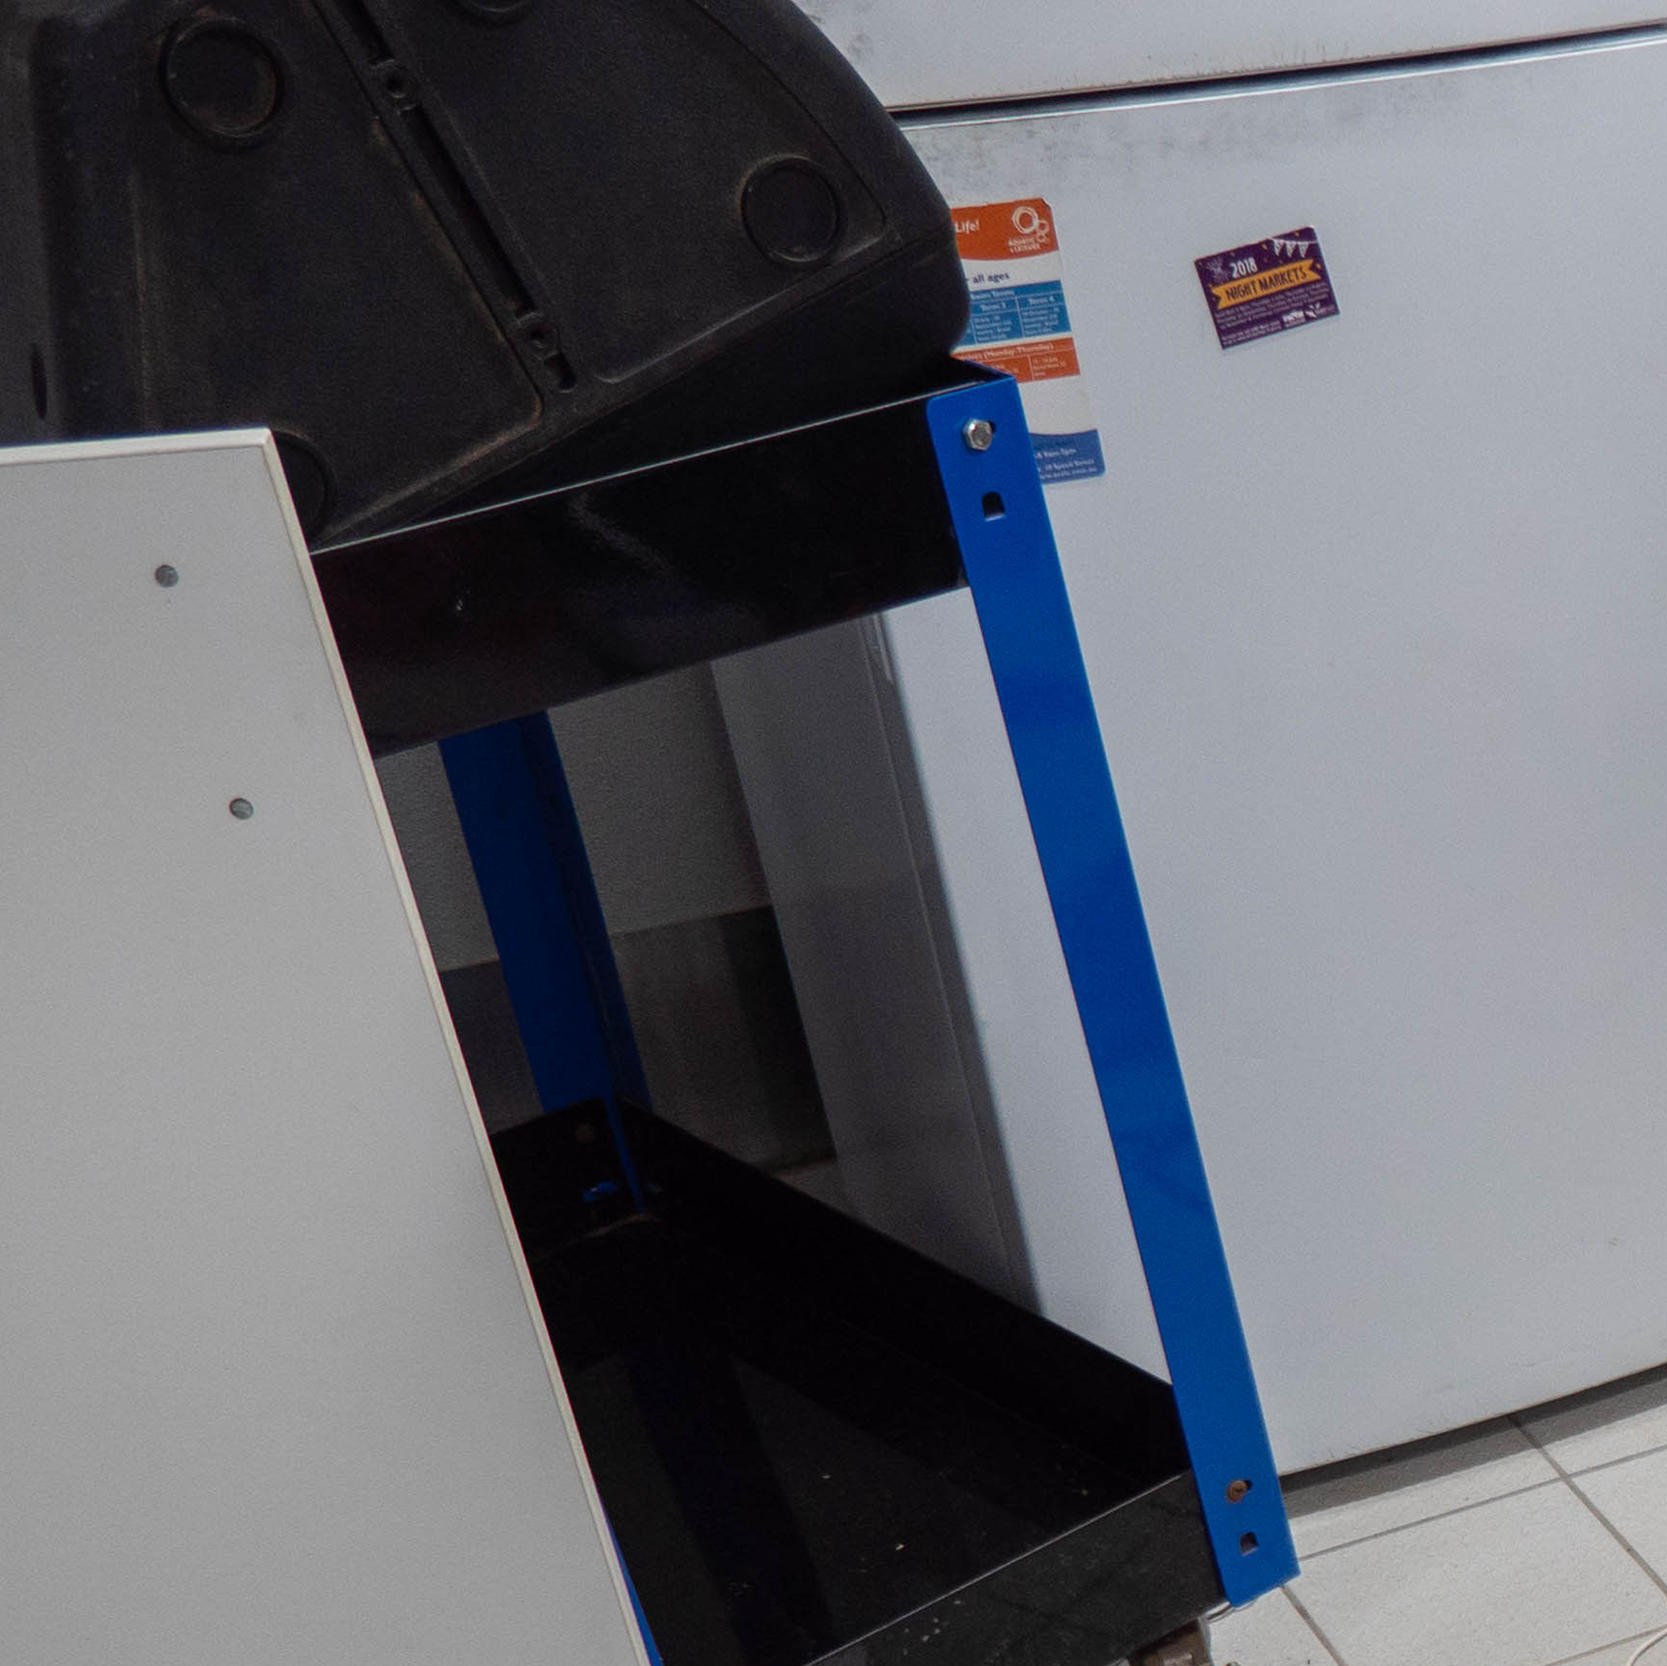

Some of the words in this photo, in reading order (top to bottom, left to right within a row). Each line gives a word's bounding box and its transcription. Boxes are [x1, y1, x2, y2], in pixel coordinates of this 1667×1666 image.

[973, 274, 985, 284] all
[988, 271, 1010, 283] ages
[1229, 257, 1258, 278] 2018
[1225, 280, 1257, 301] NIGHT
[1258, 266, 1308, 291] MARKETS
